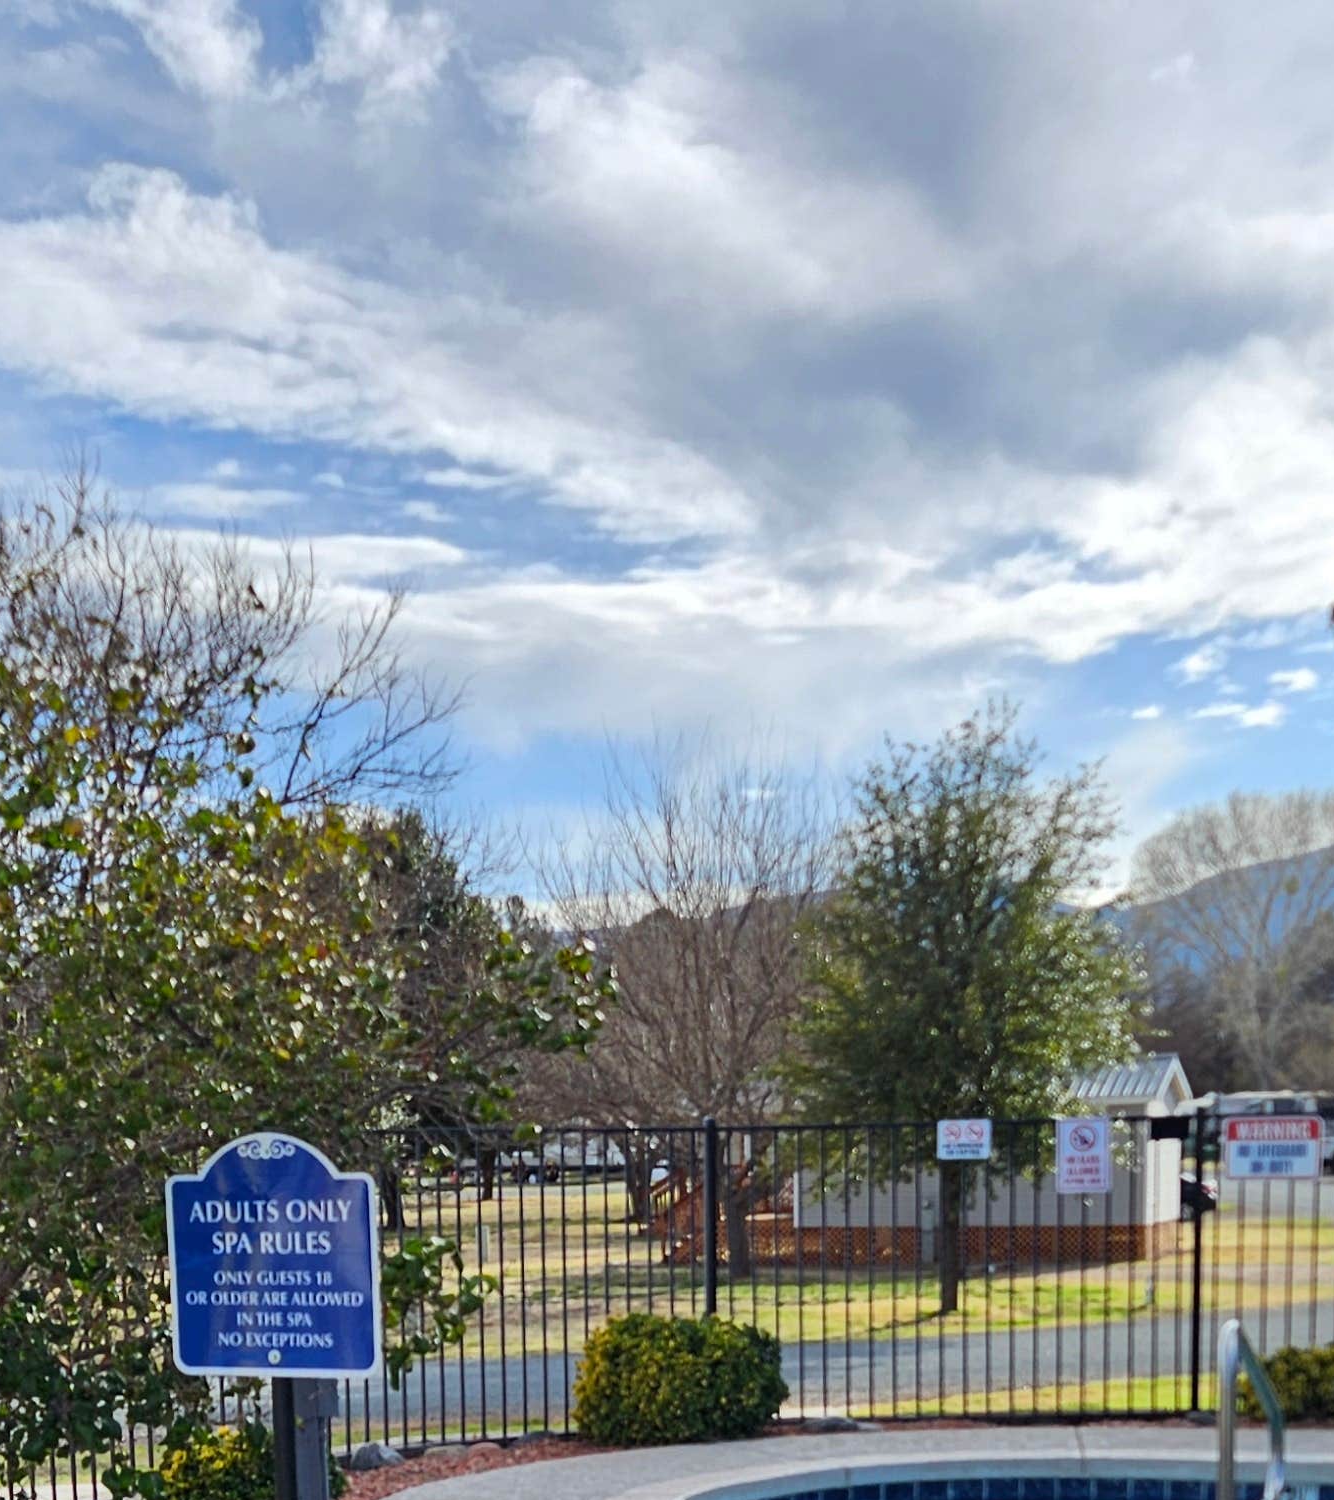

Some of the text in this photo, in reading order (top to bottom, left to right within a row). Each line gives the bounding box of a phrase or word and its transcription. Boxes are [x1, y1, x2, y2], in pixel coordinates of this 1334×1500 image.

[1237, 1121, 1311, 1140] WARNING
[189, 1199, 352, 1223] ADULTS ONLY
[211, 1231, 331, 1255] SPA RULES
[214, 1270, 333, 1286] ONLY GUESTS 18
[186, 1290, 364, 1307] OR OLDER ARE ALLOWED
[236, 1312, 312, 1327] IN THE SPA
[218, 1332, 334, 1347] NO EXCEPTIONS
